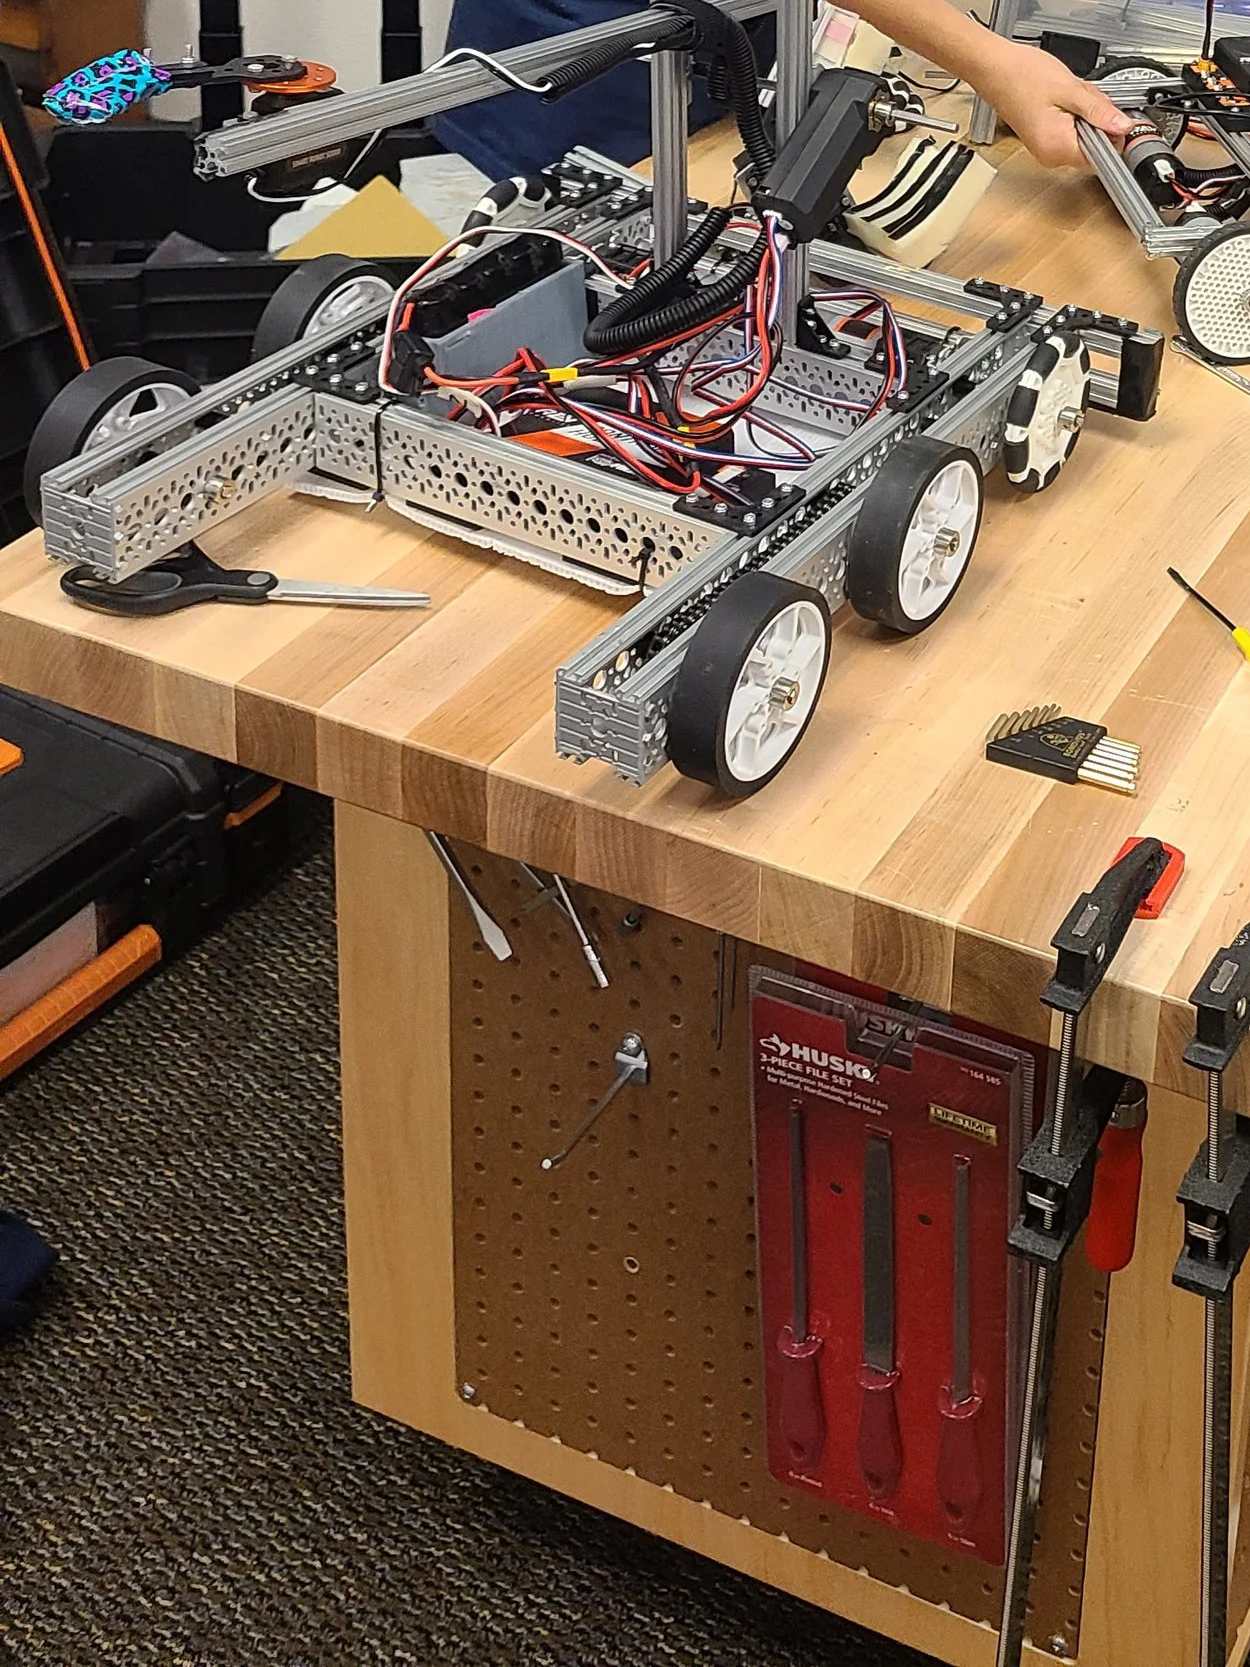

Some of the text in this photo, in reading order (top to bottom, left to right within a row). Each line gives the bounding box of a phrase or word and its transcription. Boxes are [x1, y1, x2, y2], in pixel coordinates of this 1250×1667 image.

[760, 1052, 854, 1088] 3-PIECE FILE SET
